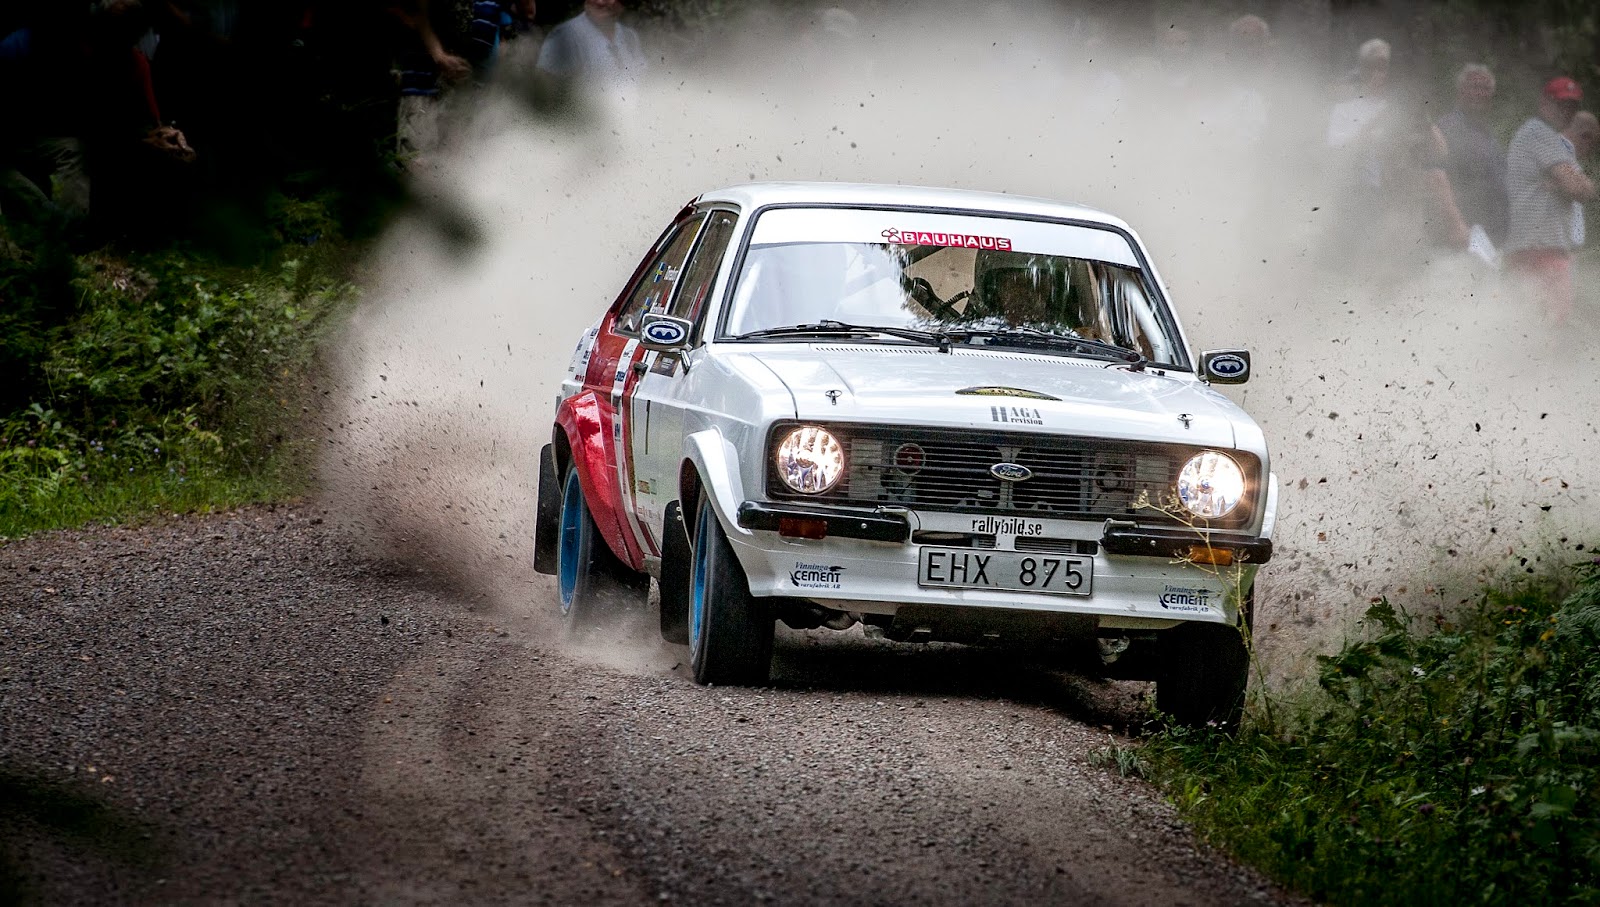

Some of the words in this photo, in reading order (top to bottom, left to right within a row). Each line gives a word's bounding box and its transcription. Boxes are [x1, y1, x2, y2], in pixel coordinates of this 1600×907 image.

[902, 231, 1011, 250] BAUHAUS
[990, 406, 1041, 422] HAGA
[1011, 417, 1043, 425] revision
[1000, 465, 1024, 478] Ford
[972, 516, 1042, 536] rallybild.se
[794, 570, 841, 582] CEMENT
[927, 552, 991, 584] EHX
[1019, 557, 1083, 589] 875
